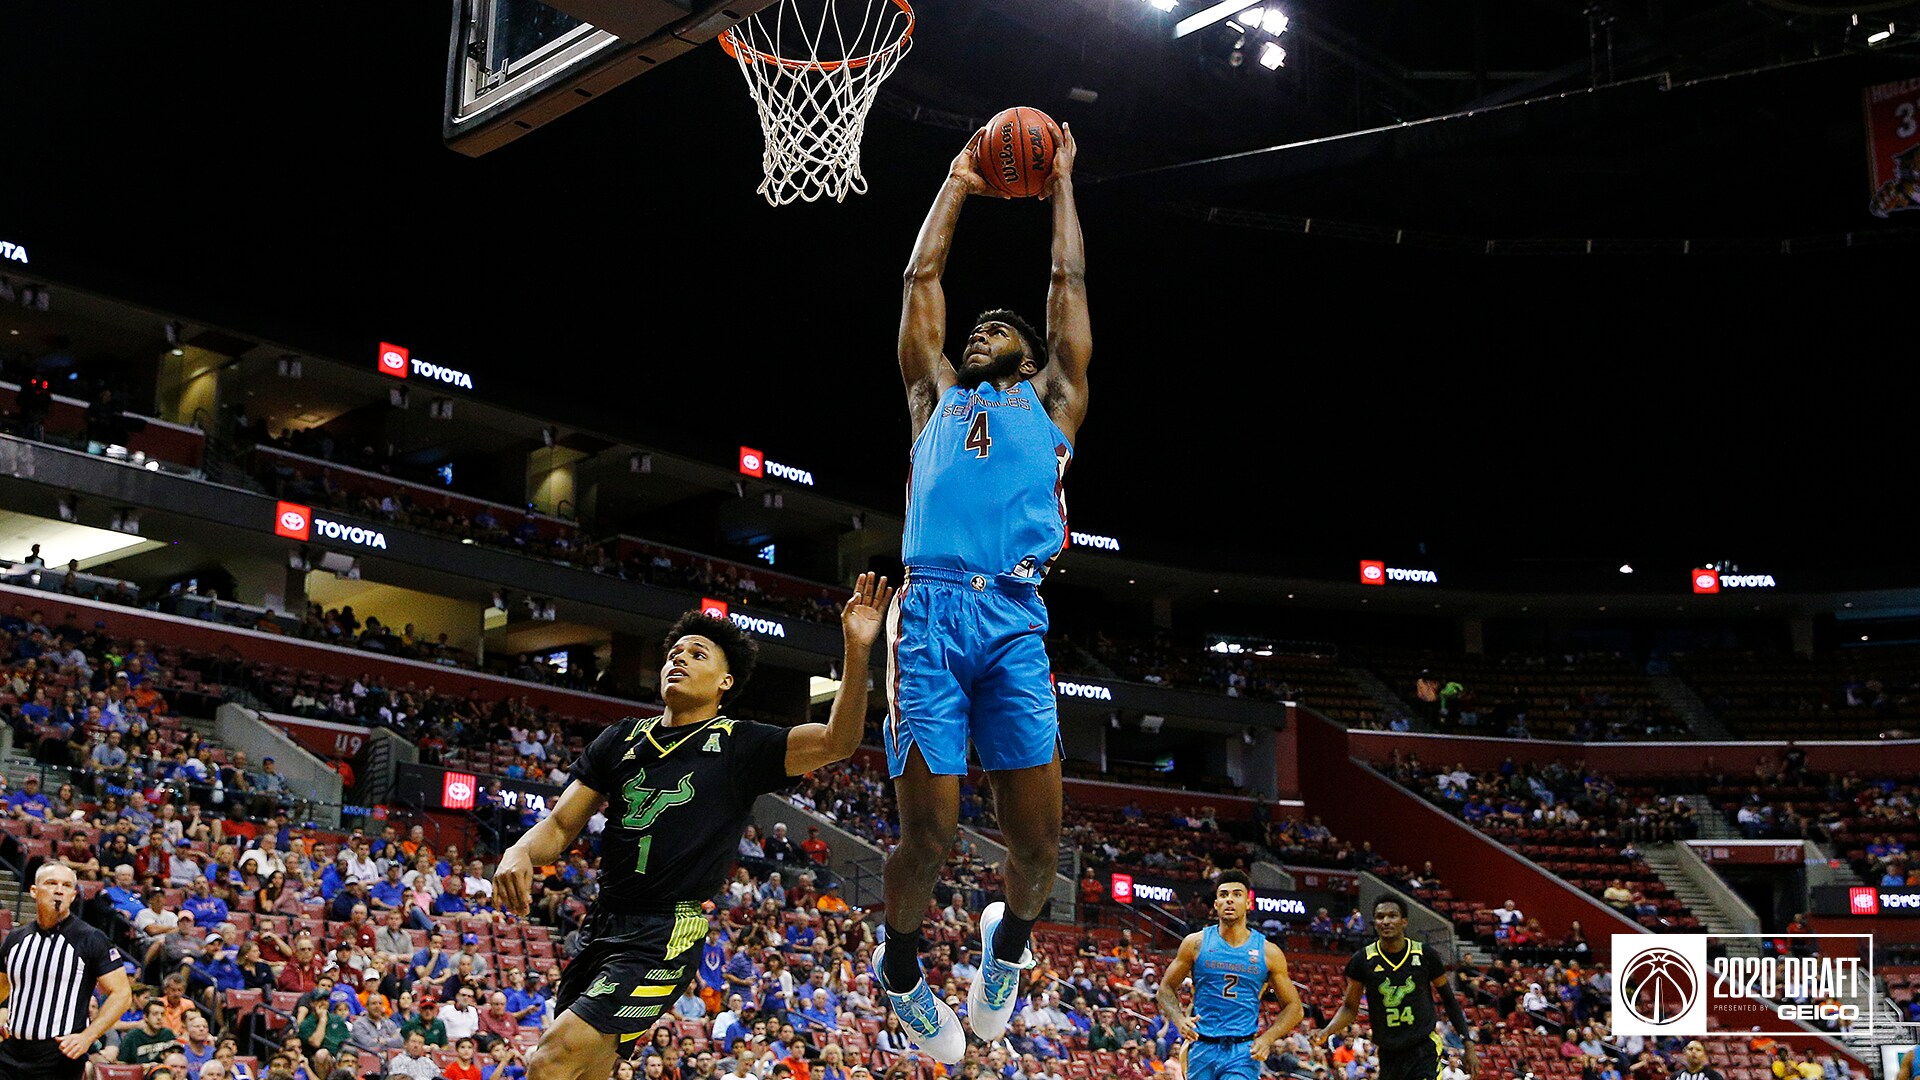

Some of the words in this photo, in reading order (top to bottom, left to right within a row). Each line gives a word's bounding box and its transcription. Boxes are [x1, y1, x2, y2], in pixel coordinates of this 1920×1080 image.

[999, 121, 1019, 183] Wilson
[1028, 126, 1044, 171] NCAA
[410, 358, 472, 389] TOYOTA
[965, 411, 991, 459] 4
[764, 460, 814, 486] TOYOTA
[314, 518, 387, 550] TOYOTA
[1070, 531, 1120, 551] TOYOTA
[1386, 567, 1438, 583] TOYOTA
[1719, 574, 1776, 588] TOYOTA
[729, 612, 785, 638] TOYOTA
[1057, 681, 1112, 701] TOYOTA
[634, 835, 653, 875] 1
[1255, 897, 1306, 915] TOYOTA
[1222, 973, 1239, 999] 2
[1385, 1006, 1415, 1027] 24
